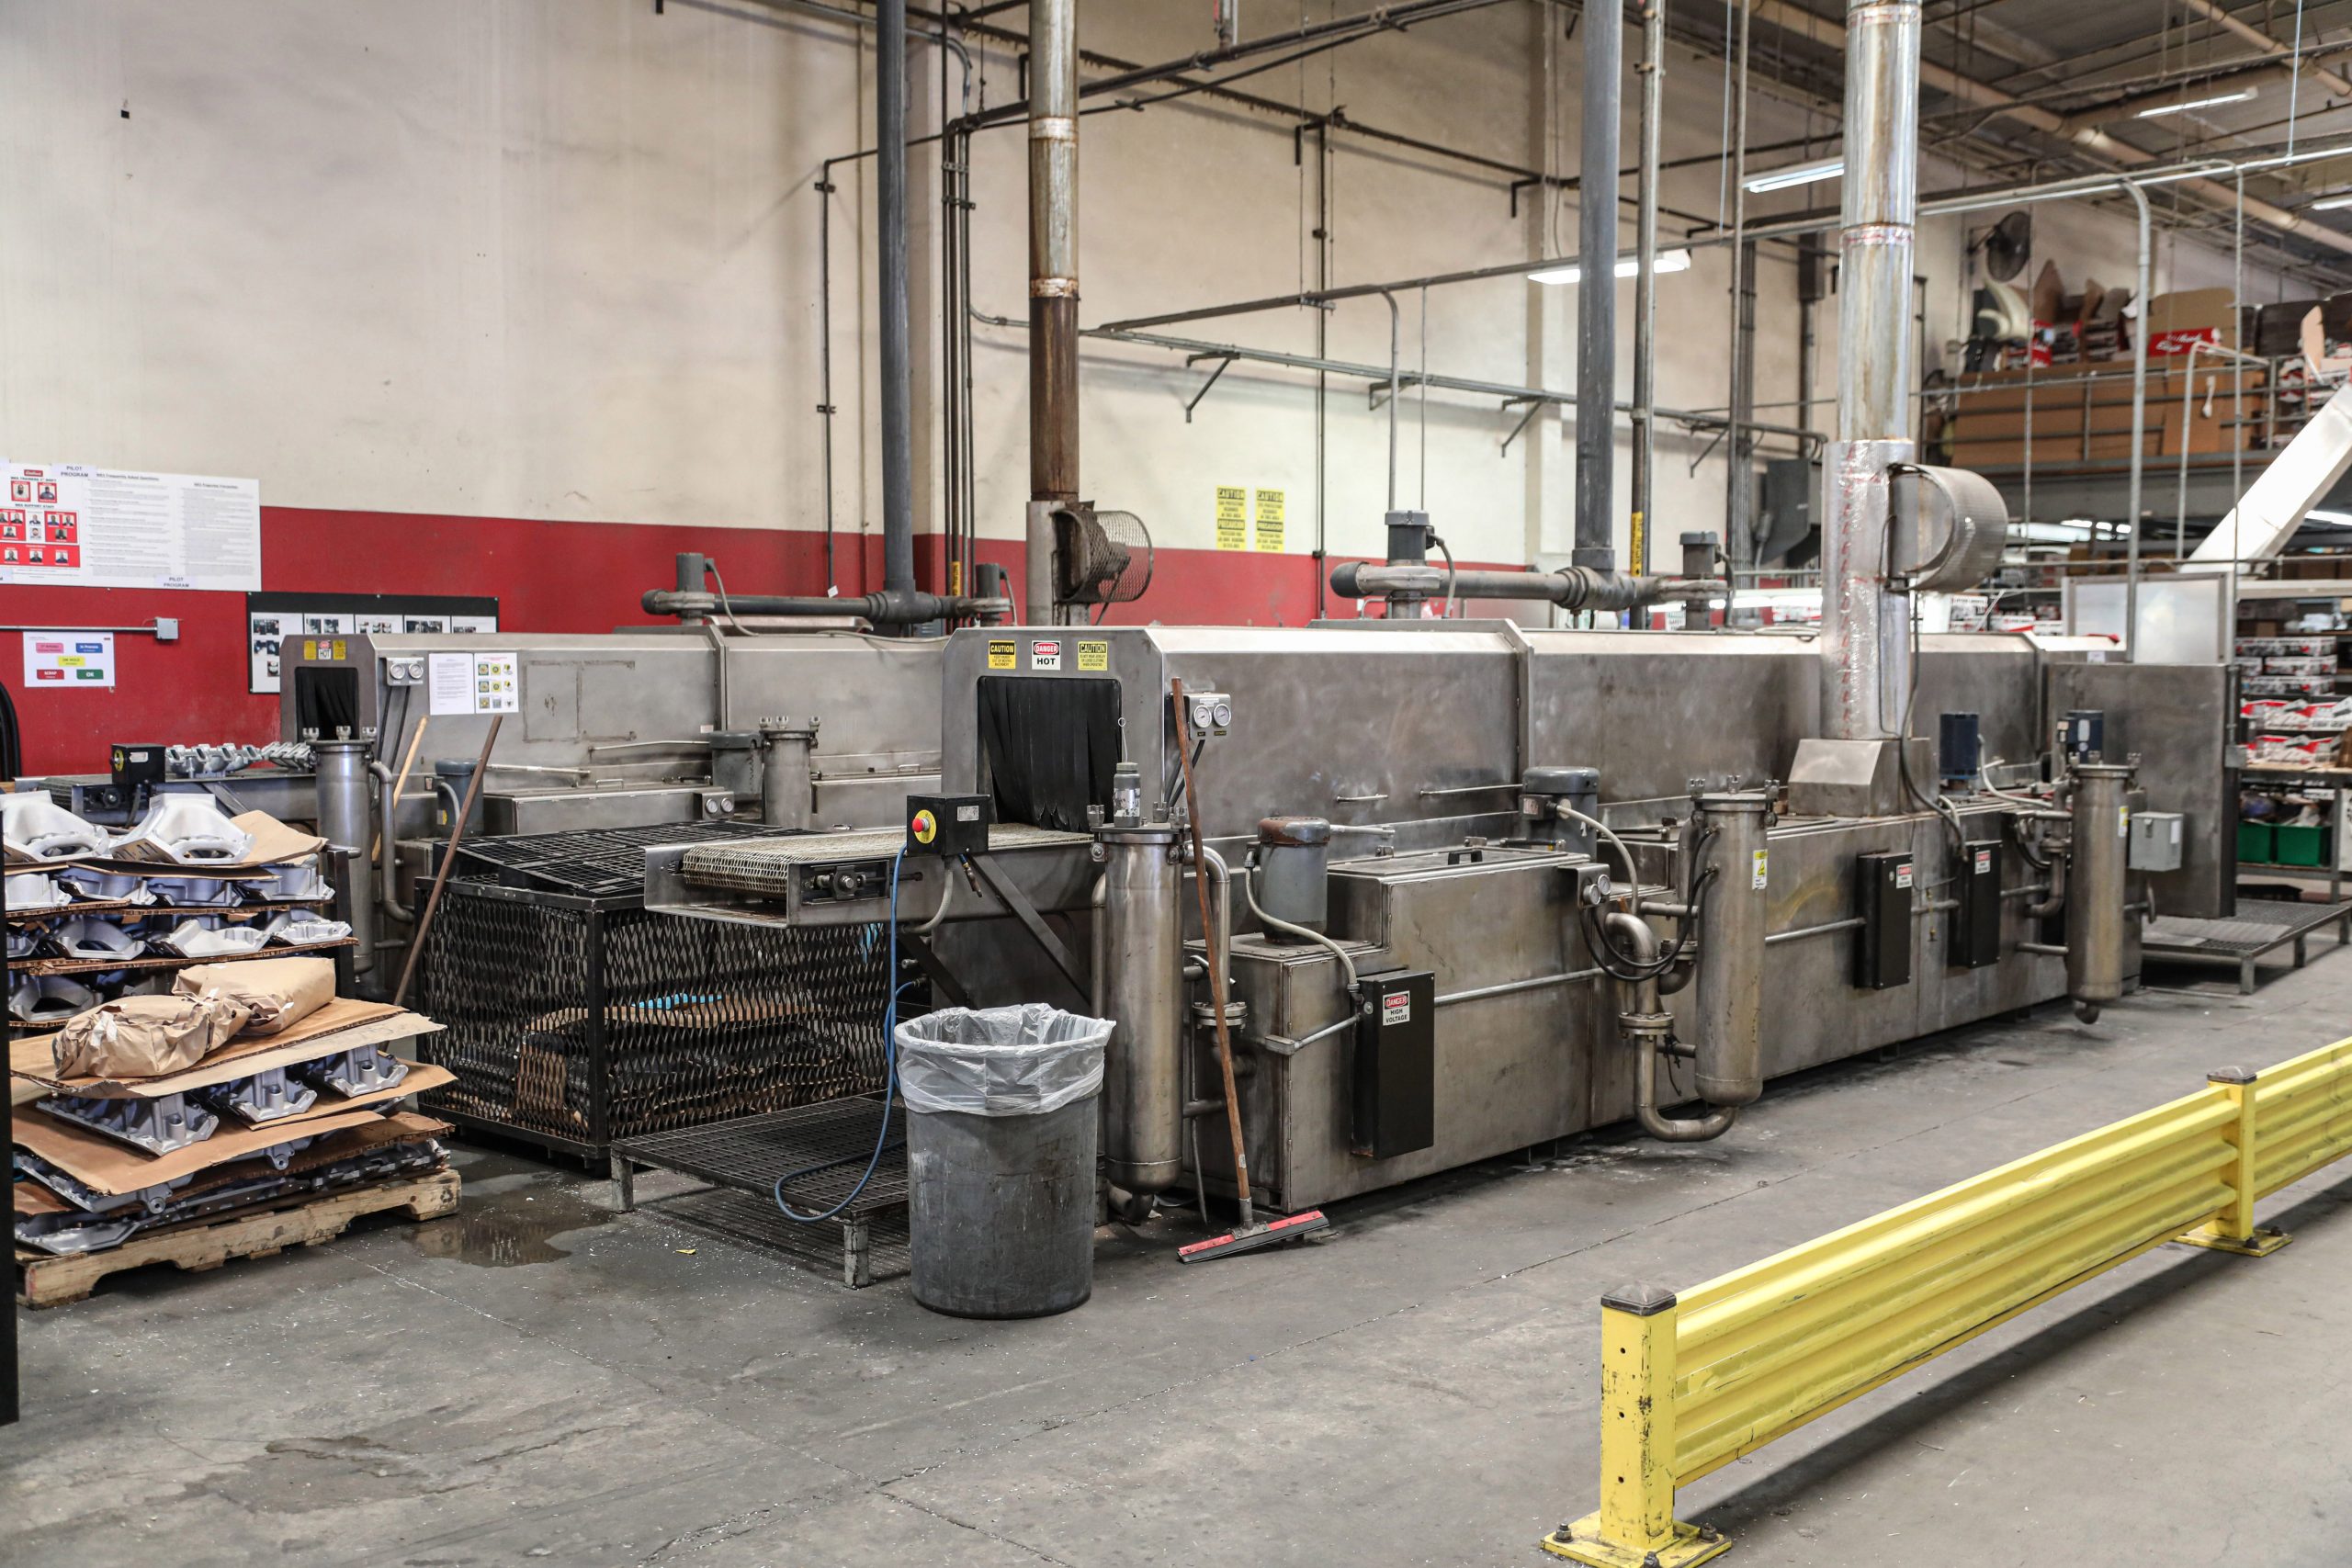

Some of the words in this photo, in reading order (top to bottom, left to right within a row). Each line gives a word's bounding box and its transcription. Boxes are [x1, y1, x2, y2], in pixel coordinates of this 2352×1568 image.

[990, 645, 1014, 653] CAUTION
[1080, 644, 1105, 653] CAUTION
[1386, 997, 1407, 1007] DANGER
[1385, 1014, 1408, 1022] VOLTAGE
